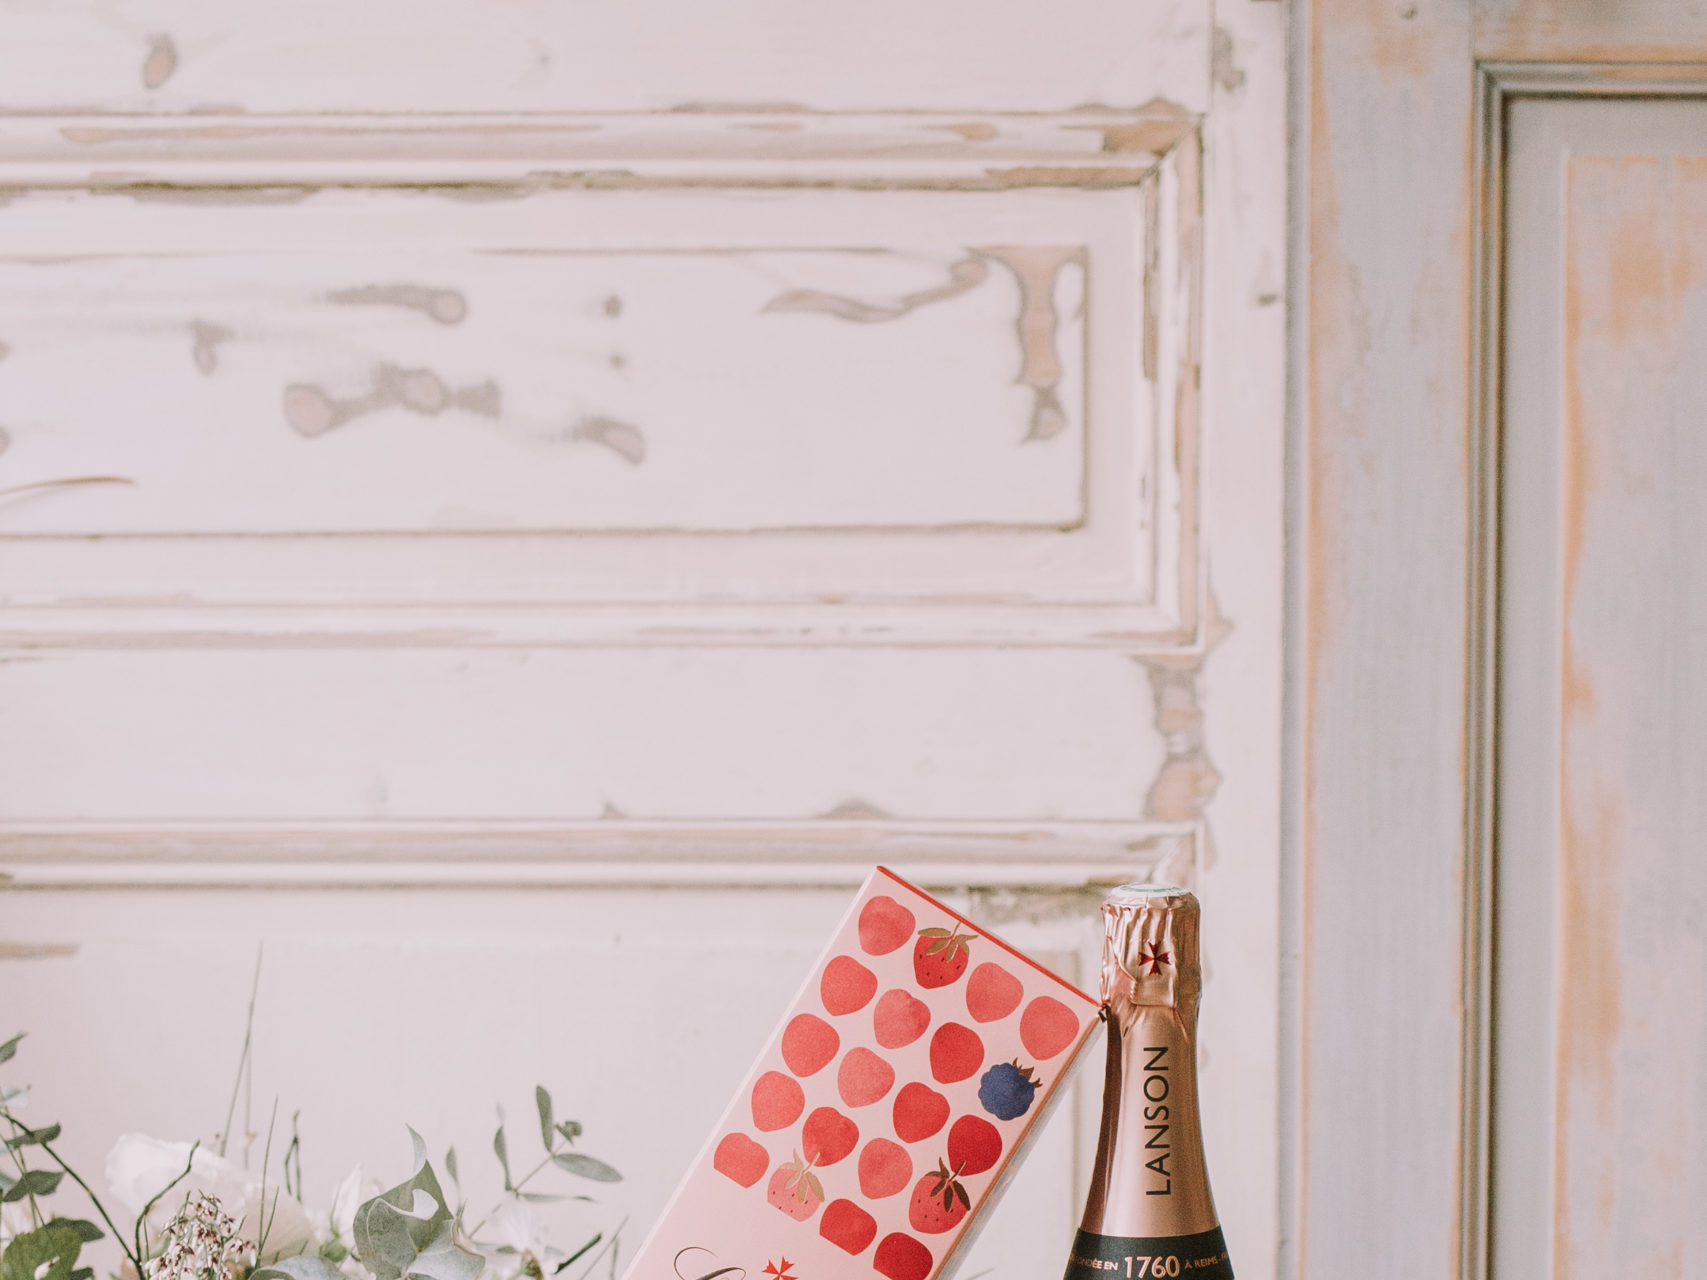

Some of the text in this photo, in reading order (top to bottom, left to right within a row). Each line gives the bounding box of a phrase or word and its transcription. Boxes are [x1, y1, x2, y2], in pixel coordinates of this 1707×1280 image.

[1143, 1046, 1171, 1196] LANSON
[1104, 1260, 1119, 1271] EN
[1124, 1255, 1181, 1279] 1760
